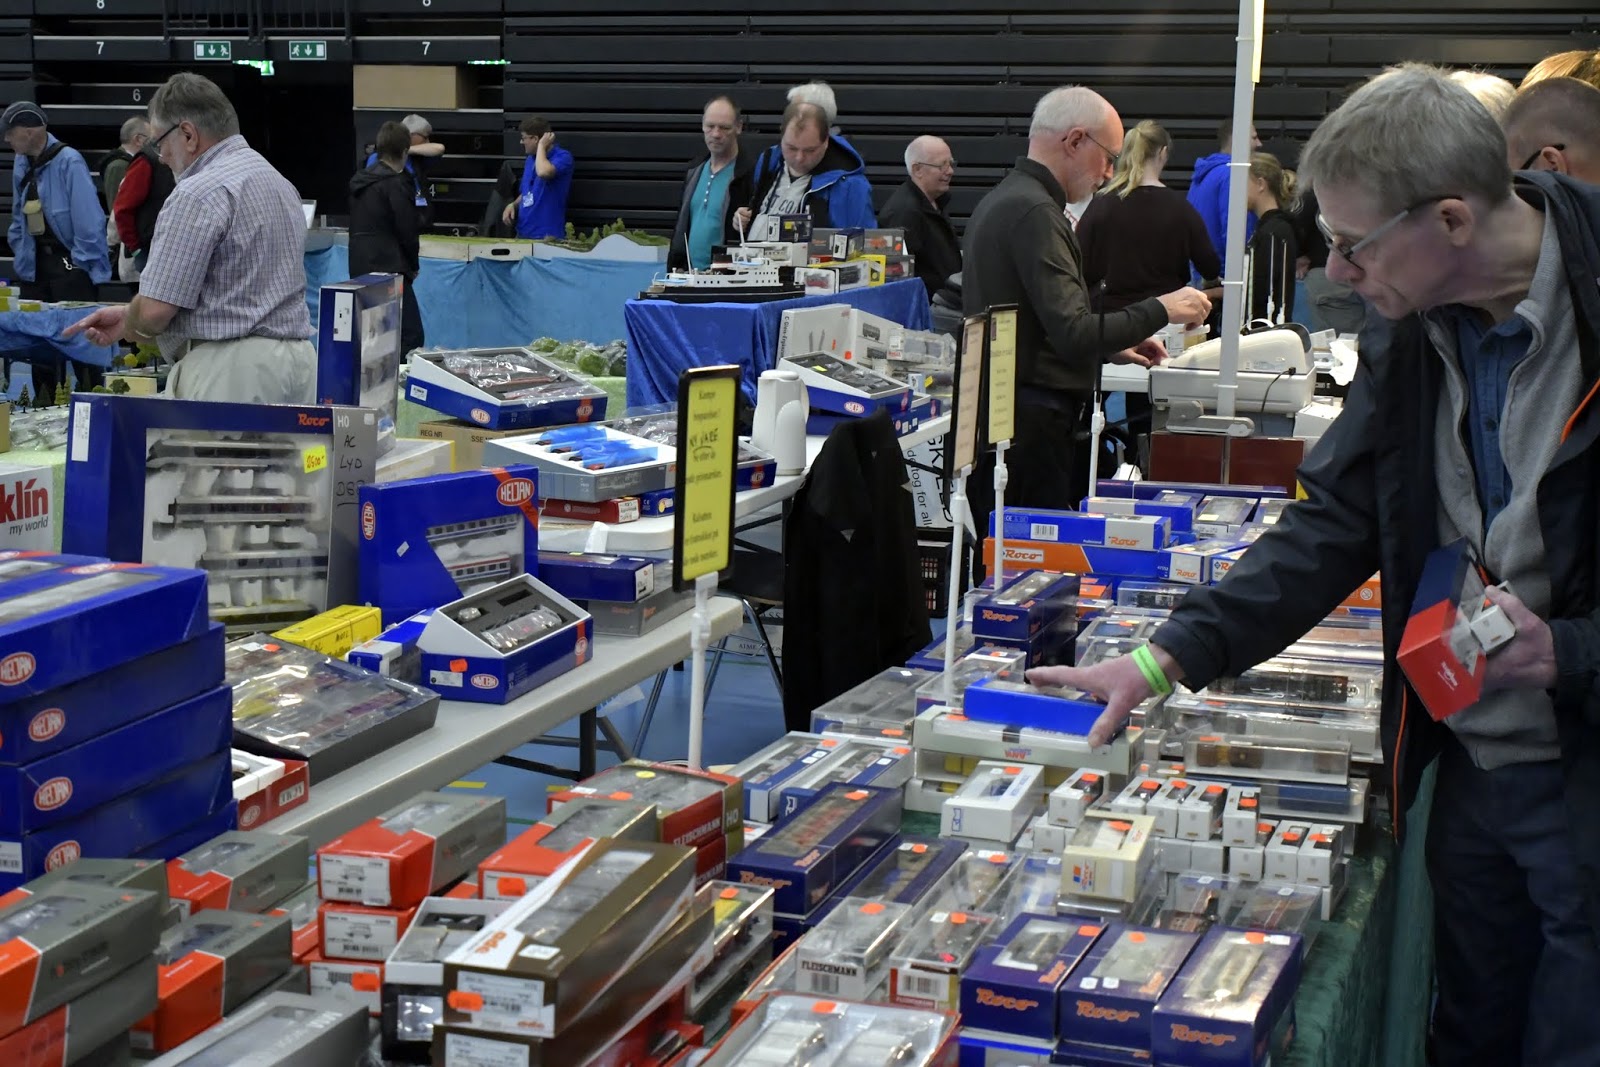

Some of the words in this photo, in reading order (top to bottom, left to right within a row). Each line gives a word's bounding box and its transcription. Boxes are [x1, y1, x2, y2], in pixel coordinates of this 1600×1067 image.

[96, 41, 105, 55] 7
[422, 41, 431, 55] 7
[132, 89, 141, 102] 6
[428, 184, 436, 197] 4
[451, 228, 460, 237] 3
[297, 413, 330, 427] Roco
[420, 429, 433, 438] REG
[434, 430, 443, 438] NR
[471, 434, 484, 443] SSE
[344, 435, 357, 449] AC
[500, 481, 532, 503] HELJAN
[916, 491, 927, 508] for
[10, 525, 24, 536] my
[25, 516, 49, 532] world
[365, 504, 374, 537] HELJAN
[1110, 536, 1140, 547] Roco
[1005, 549, 1043, 560] Roco
[1176, 568, 1198, 578] Roco
[982, 609, 1019, 622] Roco
[739, 870, 793, 890] Roco
[801, 960, 858, 977] FLEISCHMANN
[976, 987, 1040, 1011] Roco
[1076, 999, 1141, 1023] Roco
[1170, 1023, 1237, 1047] Roco
